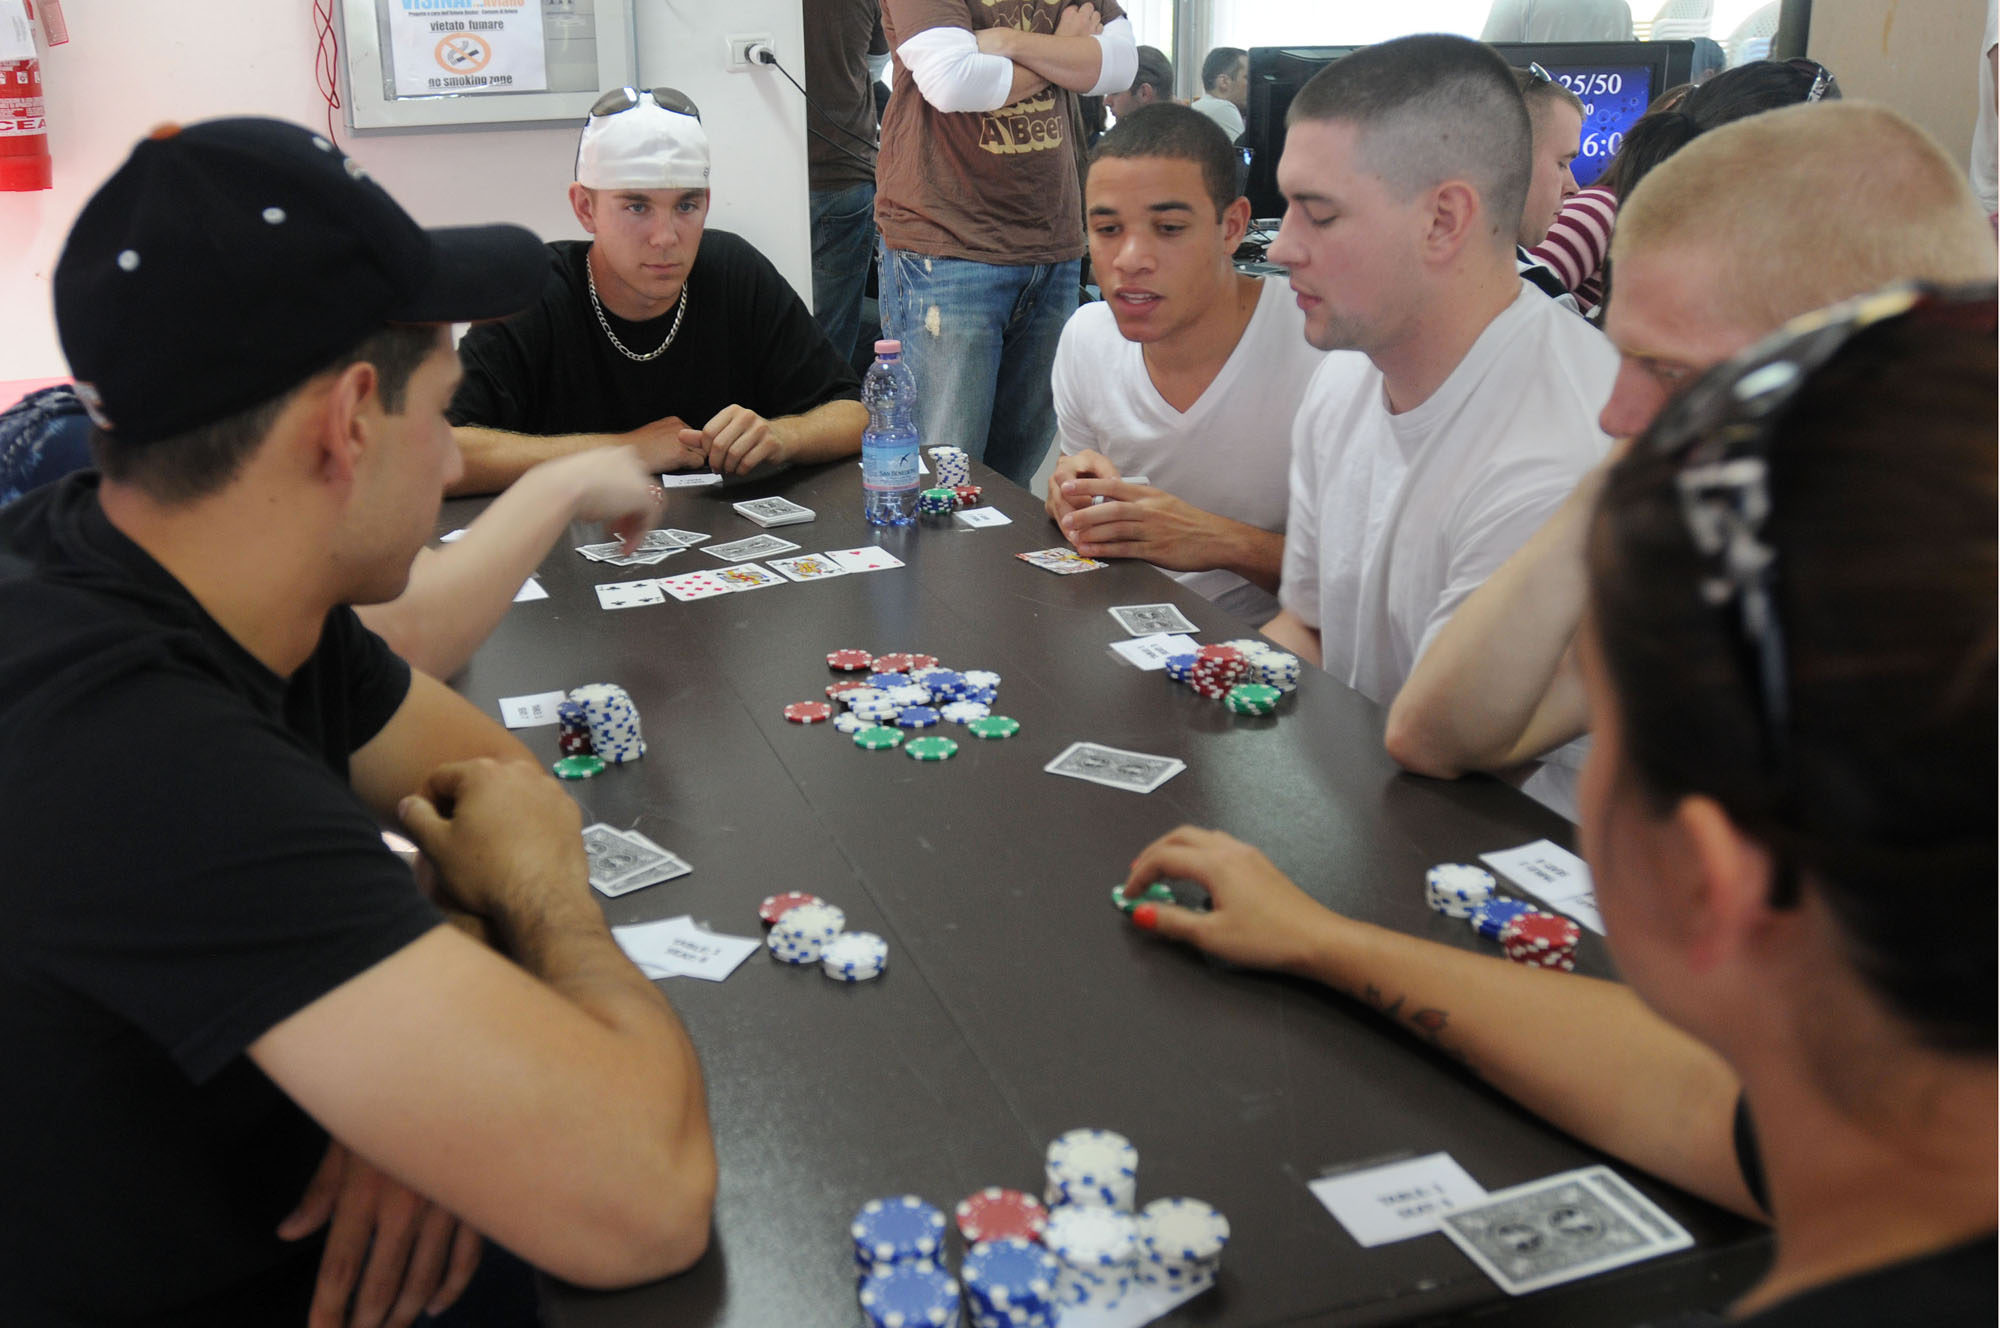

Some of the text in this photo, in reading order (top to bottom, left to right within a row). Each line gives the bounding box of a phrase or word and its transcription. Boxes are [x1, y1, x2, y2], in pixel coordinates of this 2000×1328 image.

[429, 19, 504, 31] vietato fumare
[428, 77, 441, 87] no
[444, 74, 487, 86] smoking
[1559, 73, 1622, 95] 25/50
